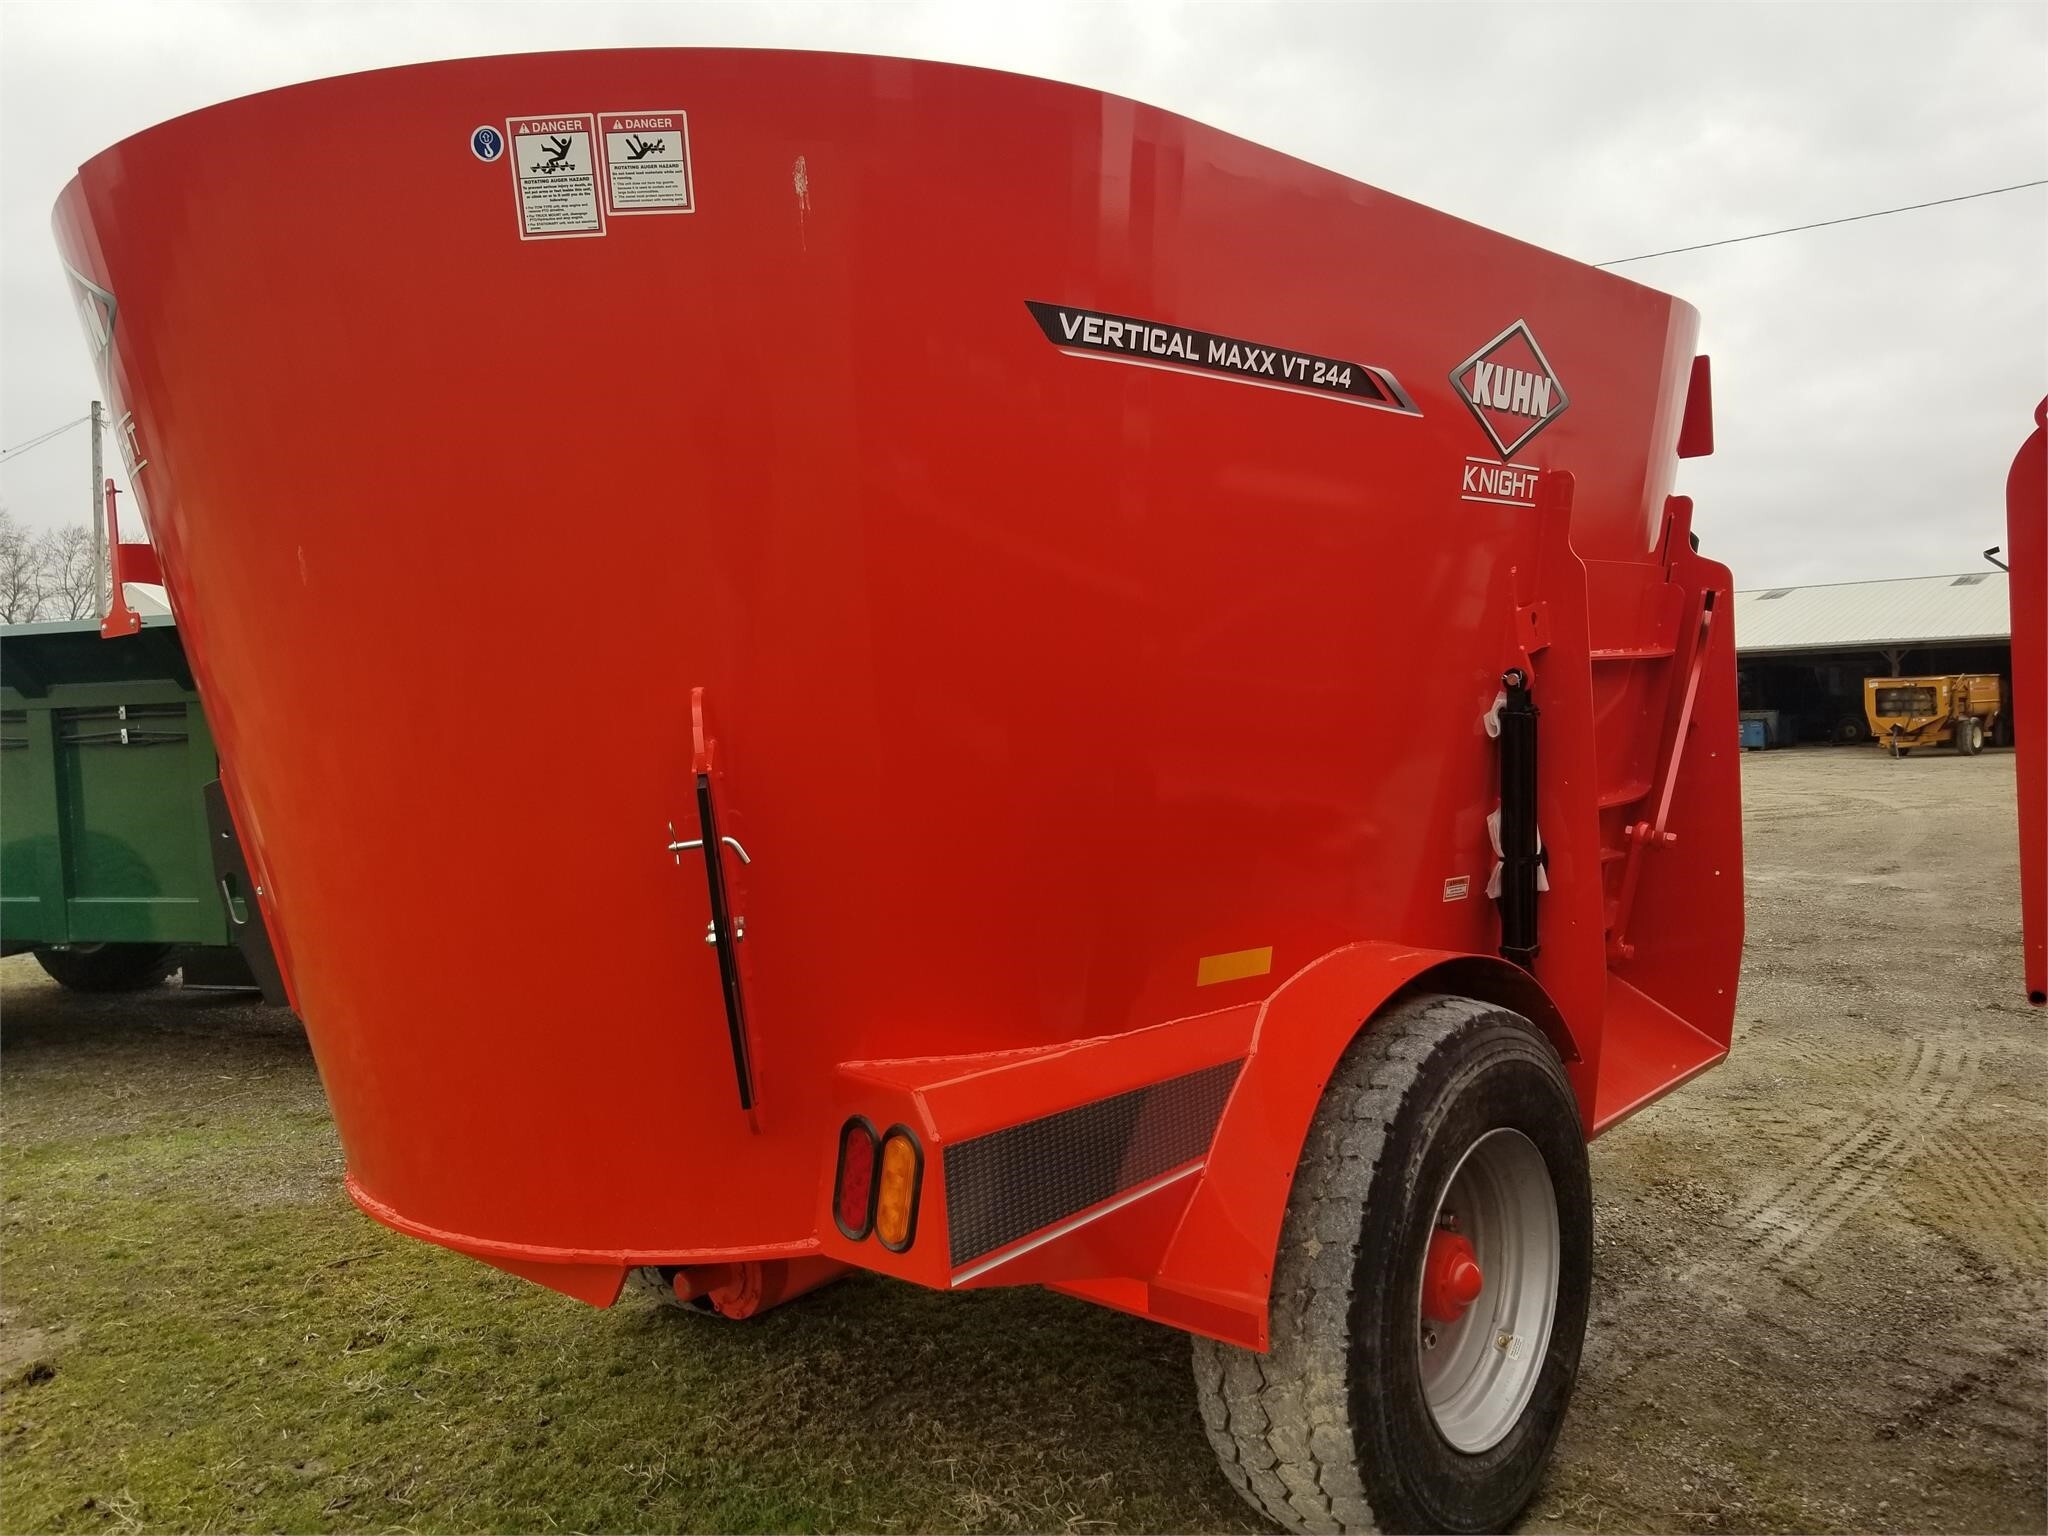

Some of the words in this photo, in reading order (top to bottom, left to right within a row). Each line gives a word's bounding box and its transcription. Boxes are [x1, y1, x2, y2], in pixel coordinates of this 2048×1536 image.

[532, 120, 582, 132] DANGER
[626, 118, 672, 128] DANGER
[1059, 312, 1199, 361] VERTICAL
[1207, 340, 1276, 375] MAXX
[1281, 355, 1310, 380] VT
[1313, 362, 1351, 388] 244
[1472, 360, 1551, 418] KUHN
[1463, 465, 1538, 498] KNIGHT
